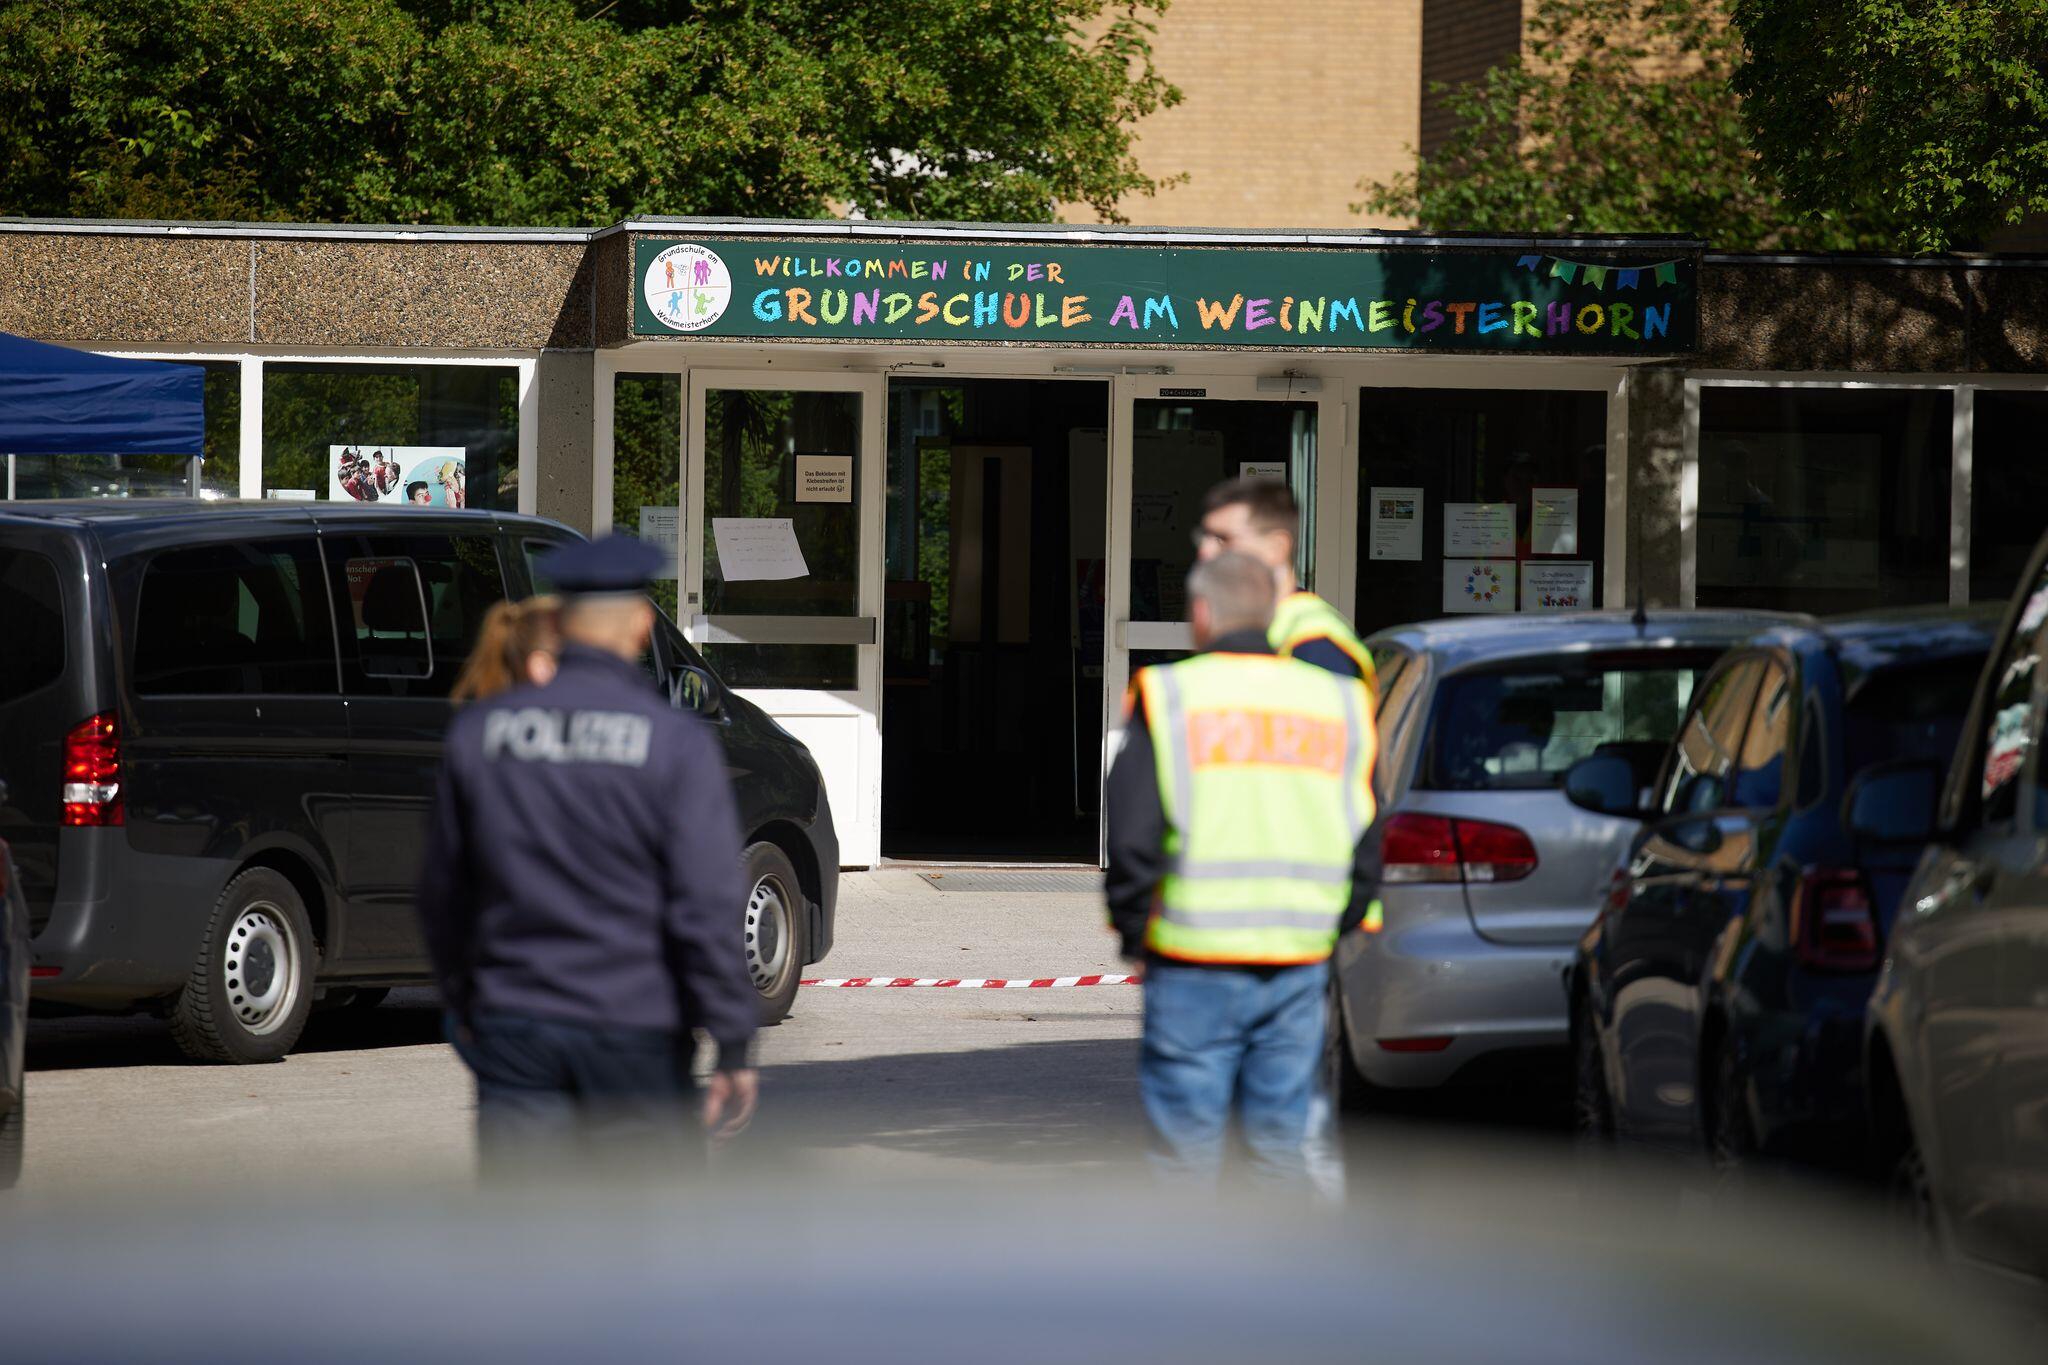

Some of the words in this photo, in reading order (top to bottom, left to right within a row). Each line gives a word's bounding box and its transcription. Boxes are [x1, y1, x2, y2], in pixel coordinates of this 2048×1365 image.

[658, 246, 706, 263] Grundschule
[707, 254, 718, 264] am
[1007, 263, 1065, 284] DER
[657, 309, 719, 328] Weinmeisterhorn
[751, 287, 1092, 328] GRUNDSCHULE
[1109, 295, 1178, 330] AM
[483, 708, 653, 768] POLIZEI
